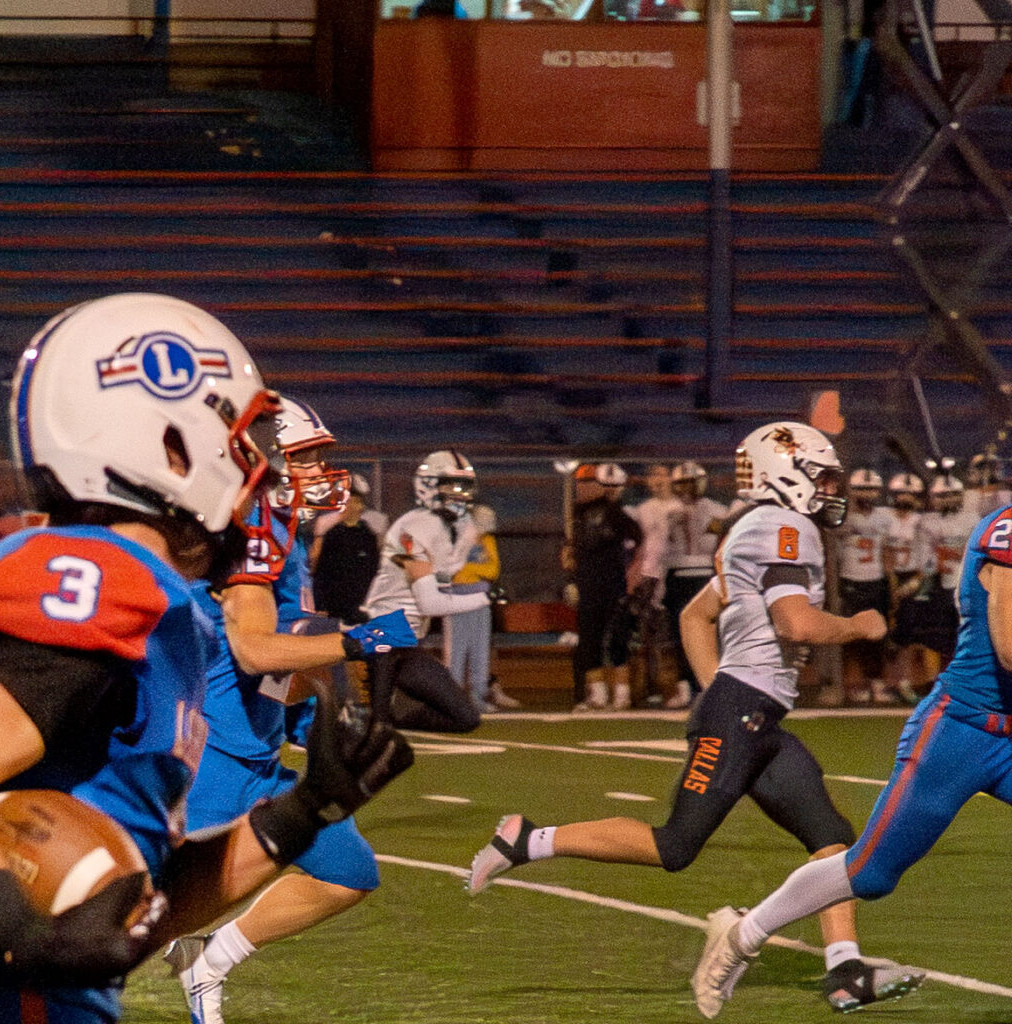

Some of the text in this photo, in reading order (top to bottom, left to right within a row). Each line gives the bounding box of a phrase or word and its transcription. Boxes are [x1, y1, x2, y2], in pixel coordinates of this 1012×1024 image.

[149, 342, 189, 388] L
[40, 554, 102, 623] 3
[683, 736, 723, 795] DALLAS
